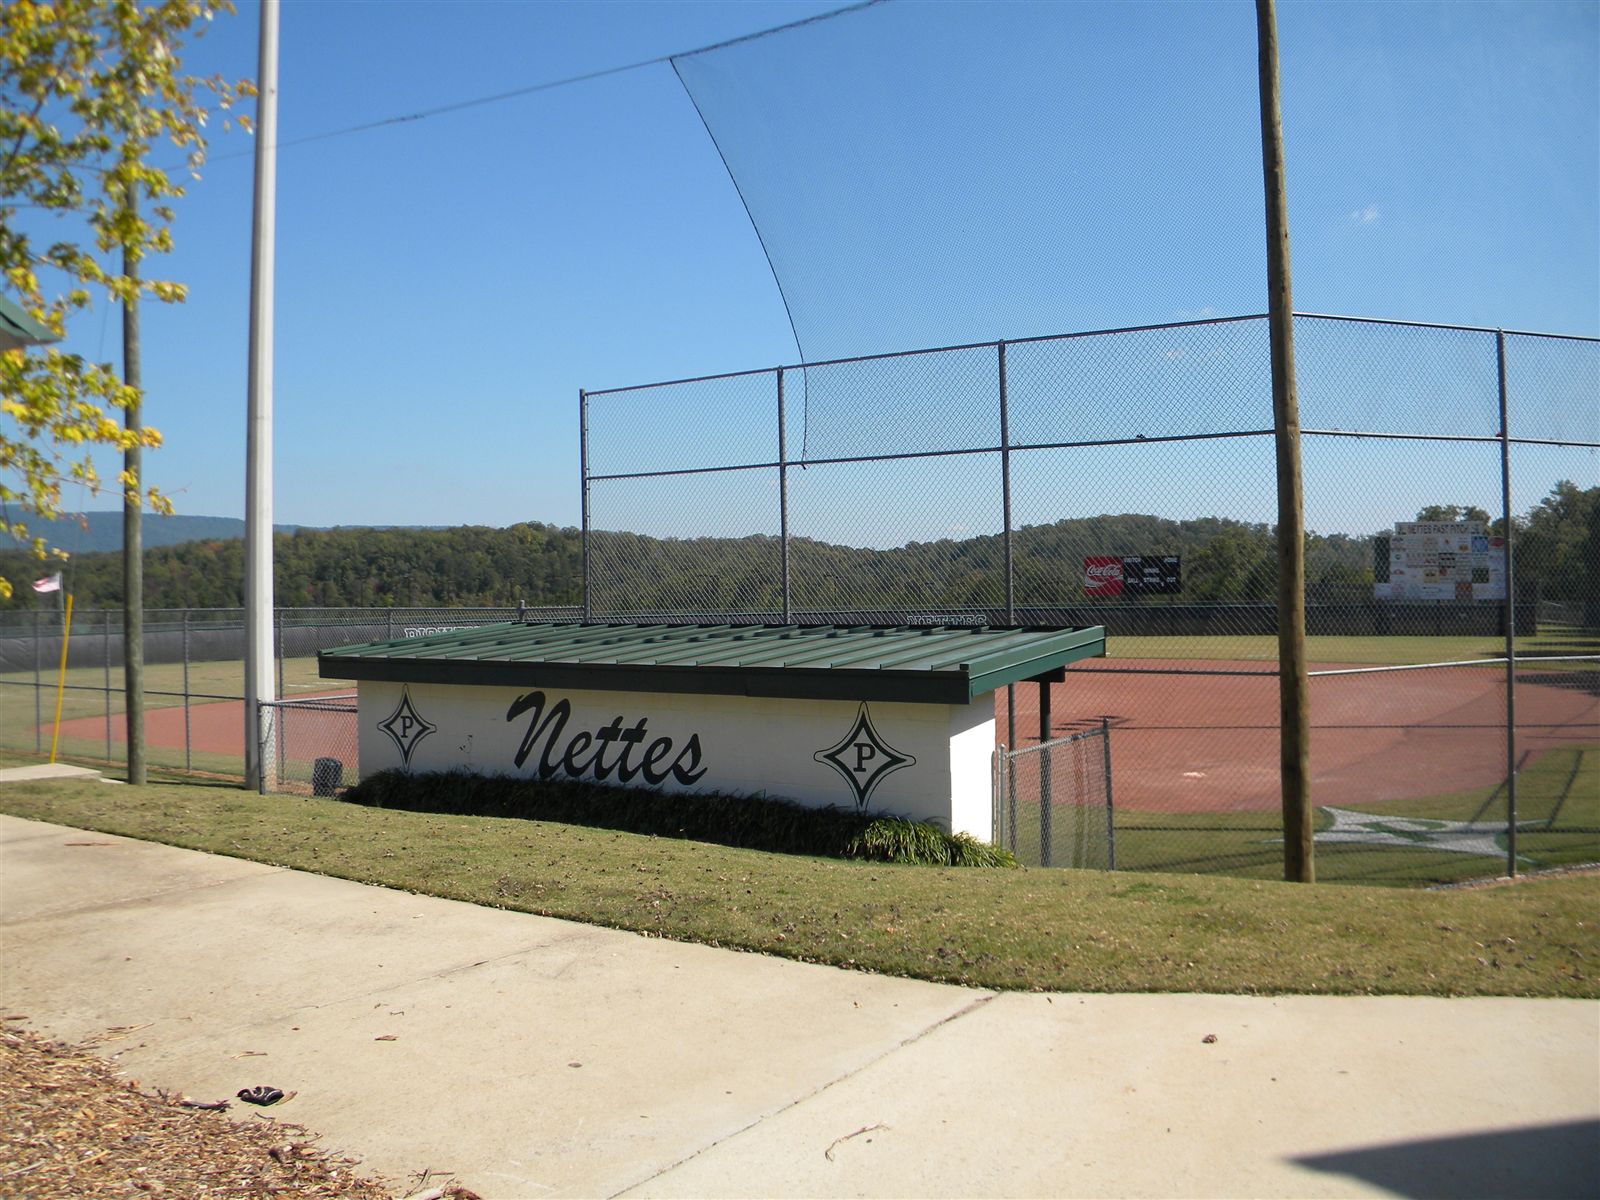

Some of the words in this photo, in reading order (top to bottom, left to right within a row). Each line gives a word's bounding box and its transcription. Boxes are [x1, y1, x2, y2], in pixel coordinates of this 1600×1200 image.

[400, 715, 414, 738] P
[506, 690, 708, 786] Nettes
[853, 742, 876, 772] P
